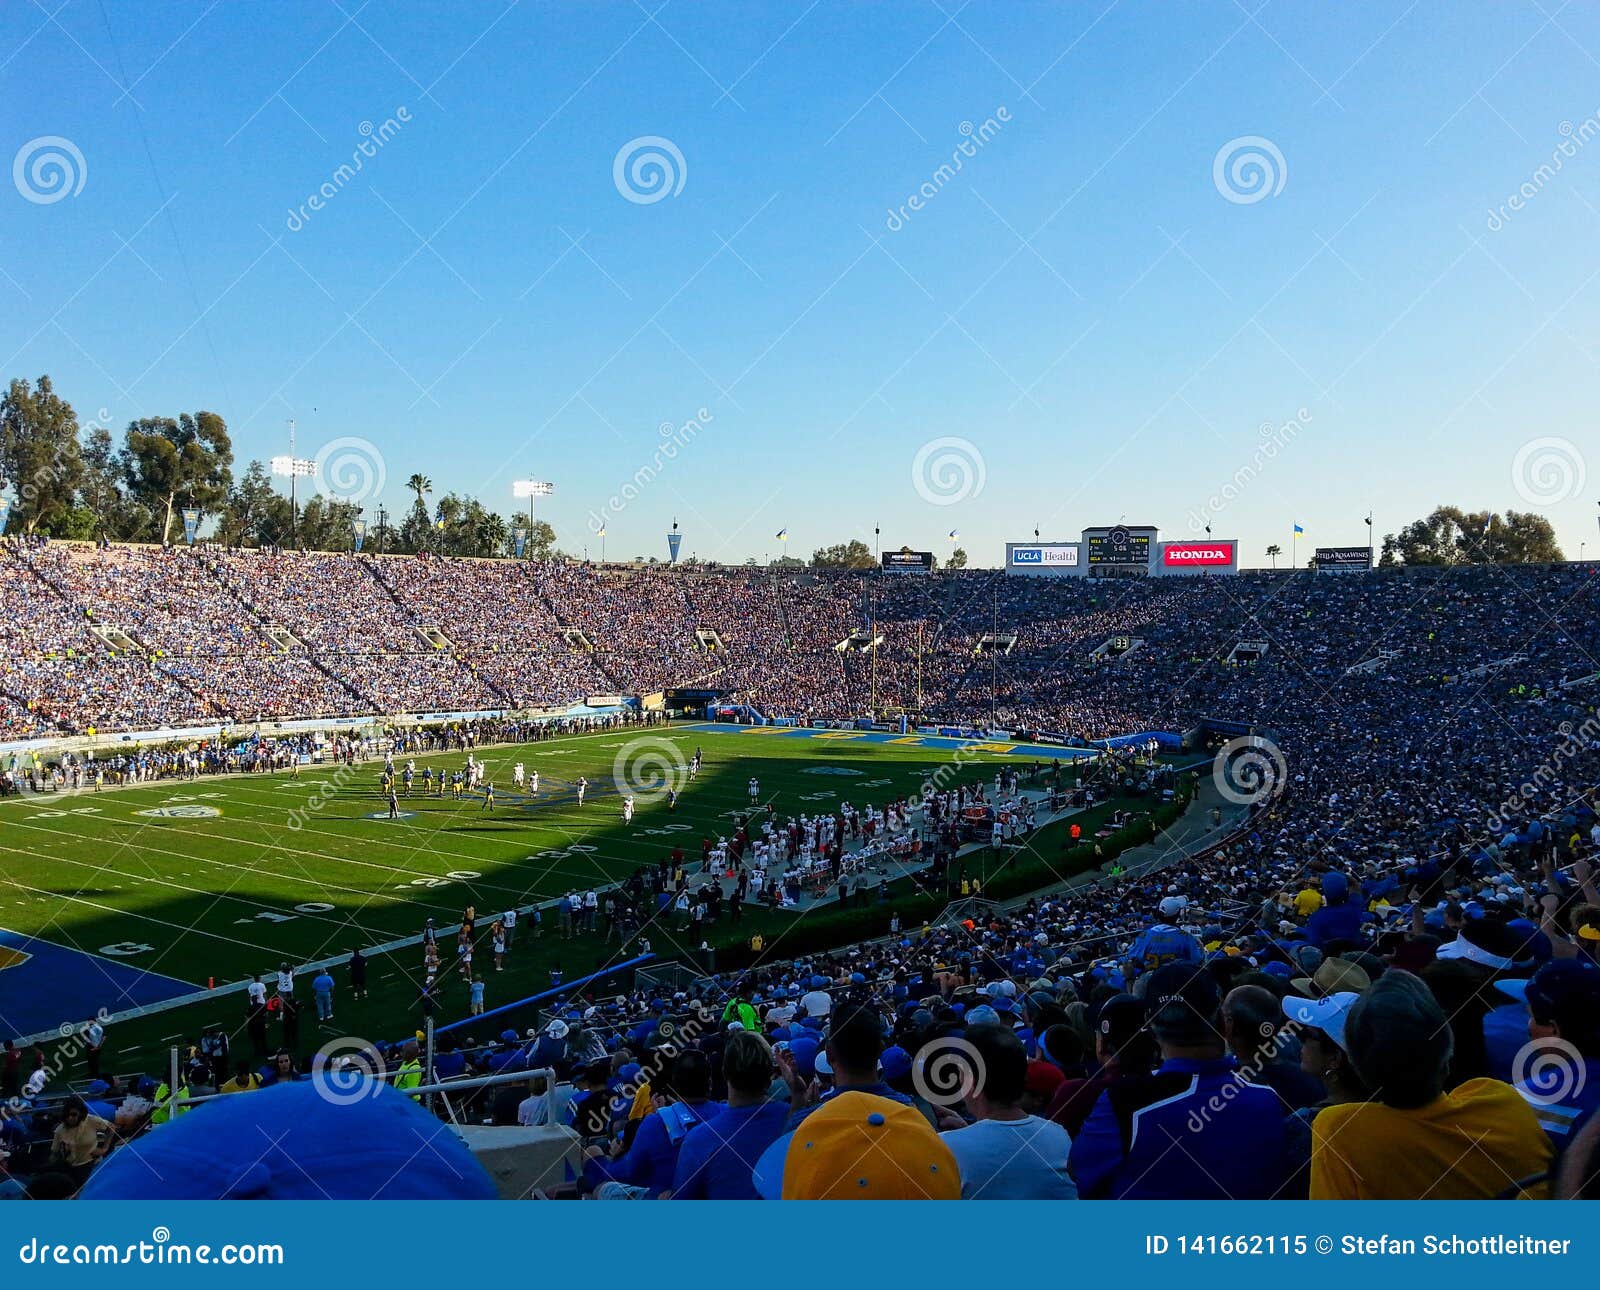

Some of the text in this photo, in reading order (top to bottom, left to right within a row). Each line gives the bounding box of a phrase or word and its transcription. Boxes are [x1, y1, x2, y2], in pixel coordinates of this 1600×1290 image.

[1017, 551, 1076, 561] UCLA Health
[1169, 550, 1226, 560] HONDA
[411, 871, 482, 888] 20
